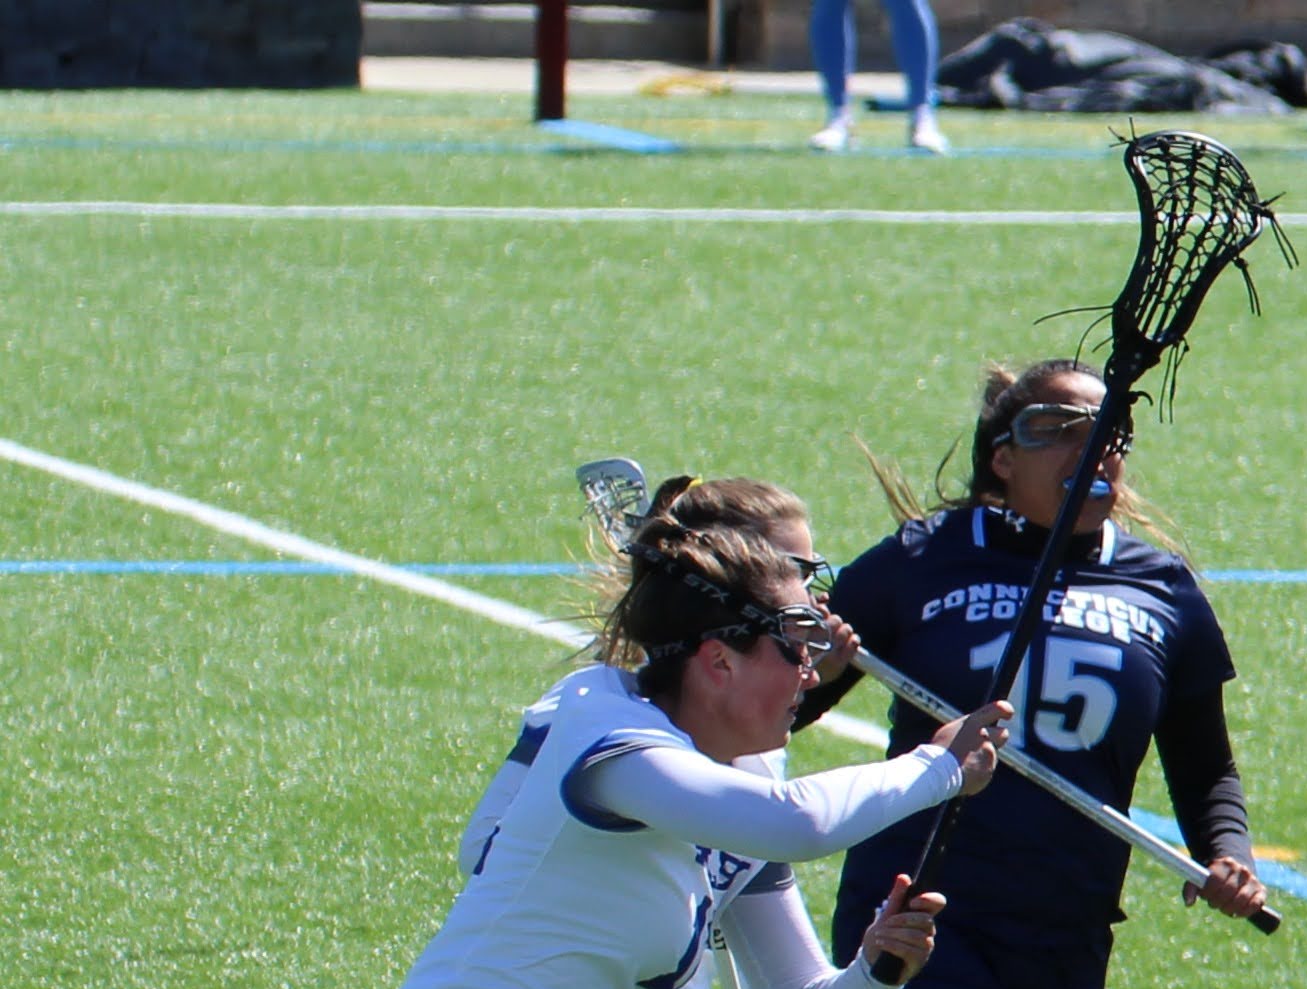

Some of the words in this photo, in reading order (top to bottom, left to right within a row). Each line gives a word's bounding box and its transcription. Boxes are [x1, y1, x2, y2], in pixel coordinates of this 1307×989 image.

[683, 572, 731, 603] STX
[921, 583, 1166, 645] CONNCTICUT
[966, 600, 1132, 645] COLEGE
[969, 631, 1123, 752] 15
